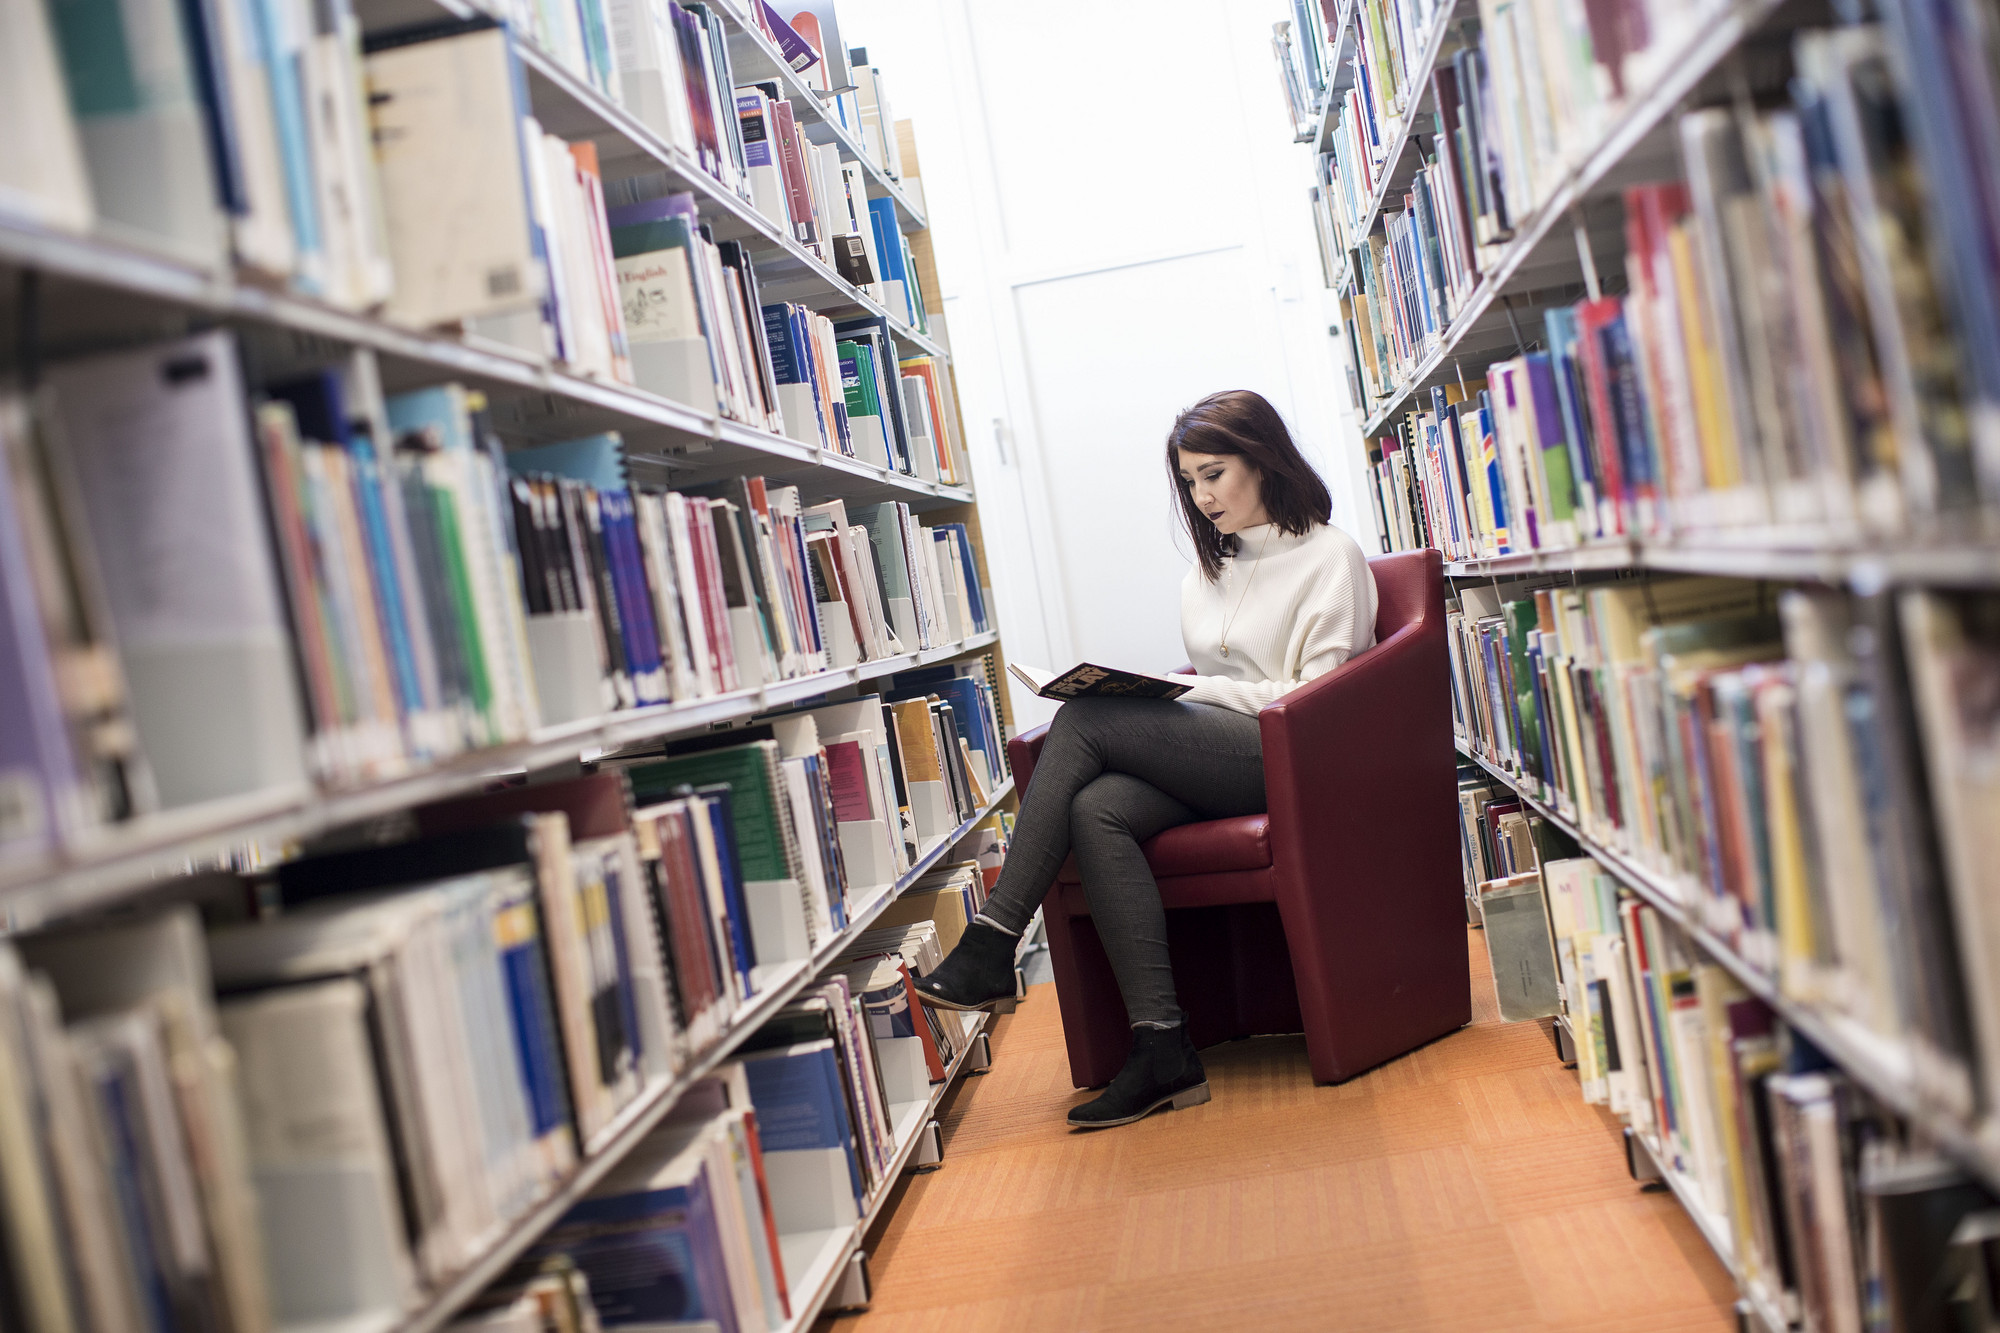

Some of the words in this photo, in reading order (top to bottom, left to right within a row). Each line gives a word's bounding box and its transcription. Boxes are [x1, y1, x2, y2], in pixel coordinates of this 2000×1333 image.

[624, 266, 667, 283] English
[1058, 668, 1110, 696] PLAY
[1469, 834, 1479, 861] VISUAL
